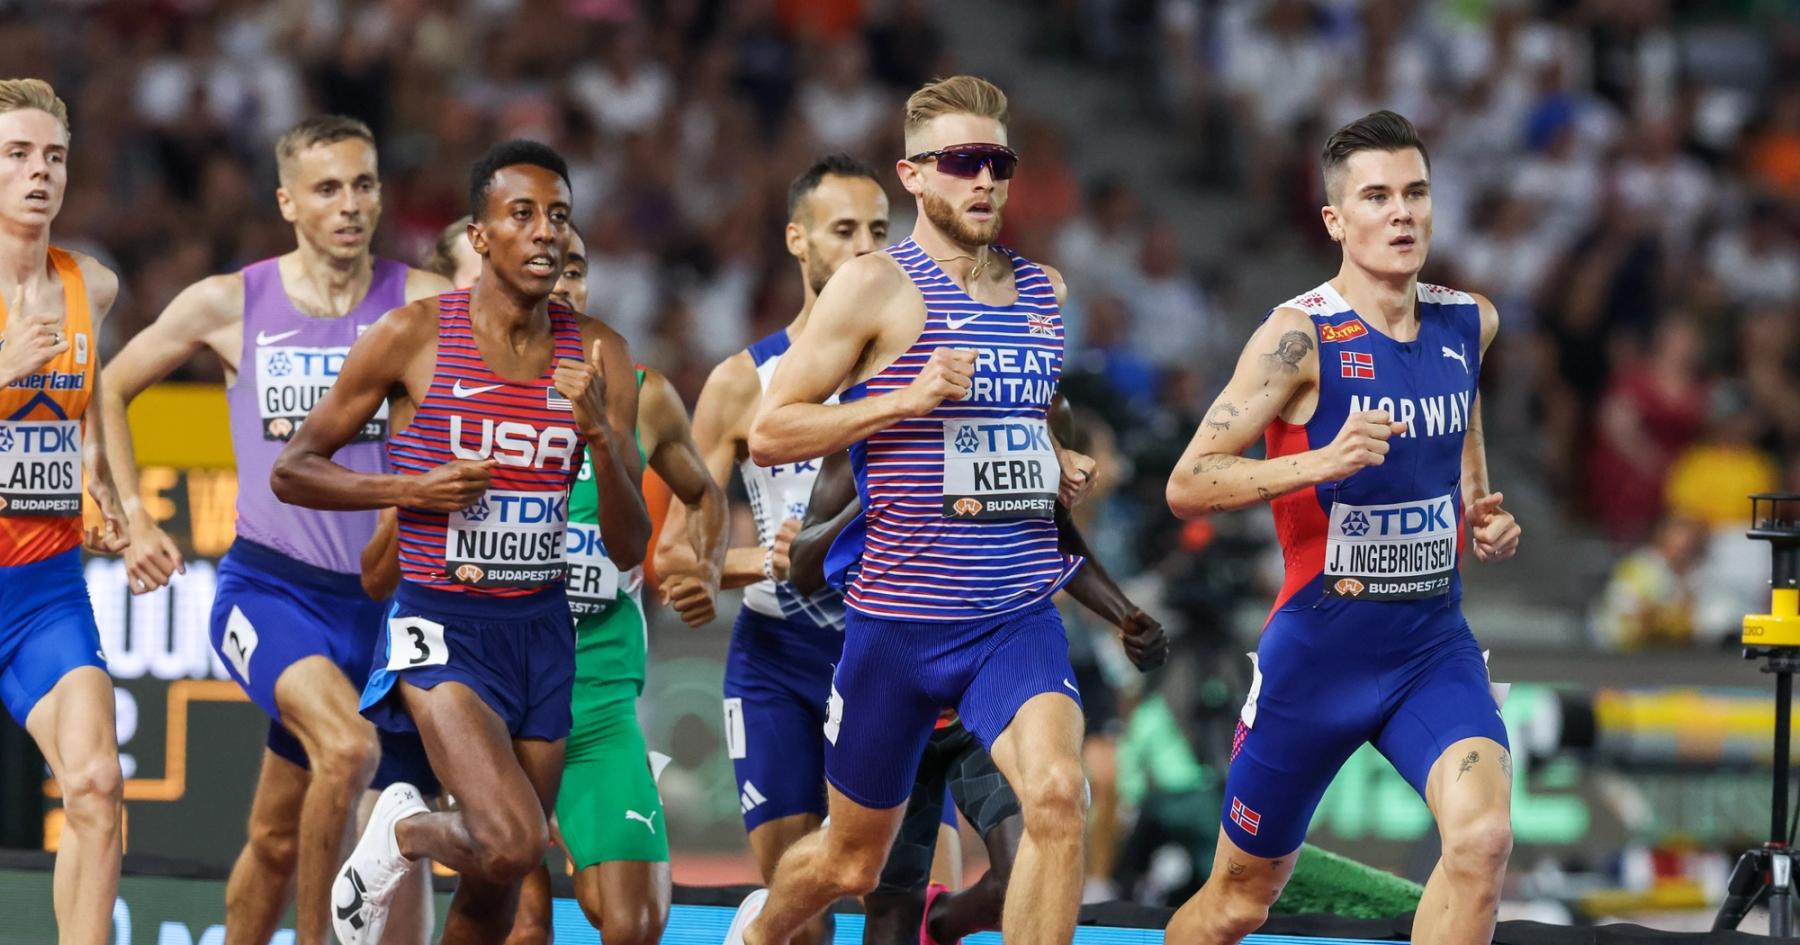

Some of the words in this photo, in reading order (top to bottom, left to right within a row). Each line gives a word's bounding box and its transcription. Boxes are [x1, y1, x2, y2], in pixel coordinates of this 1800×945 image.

[294, 352, 347, 376] TD
[954, 347, 1056, 376] REAT
[15, 425, 77, 453] TDK
[450, 415, 578, 471] USA
[977, 423, 1050, 452] TDK
[973, 460, 1044, 491] KERR
[490, 495, 565, 524] TDK
[1370, 501, 1449, 536] TDK
[456, 529, 562, 561] NUGUSE
[566, 527, 609, 558] DK
[1330, 544, 1344, 572] J.
[1350, 537, 1453, 574] INGEBRIGTSEN
[567, 563, 602, 594] ER
[1368, 580, 1435, 594] BUDAPEST
[406, 626, 430, 664] 3
